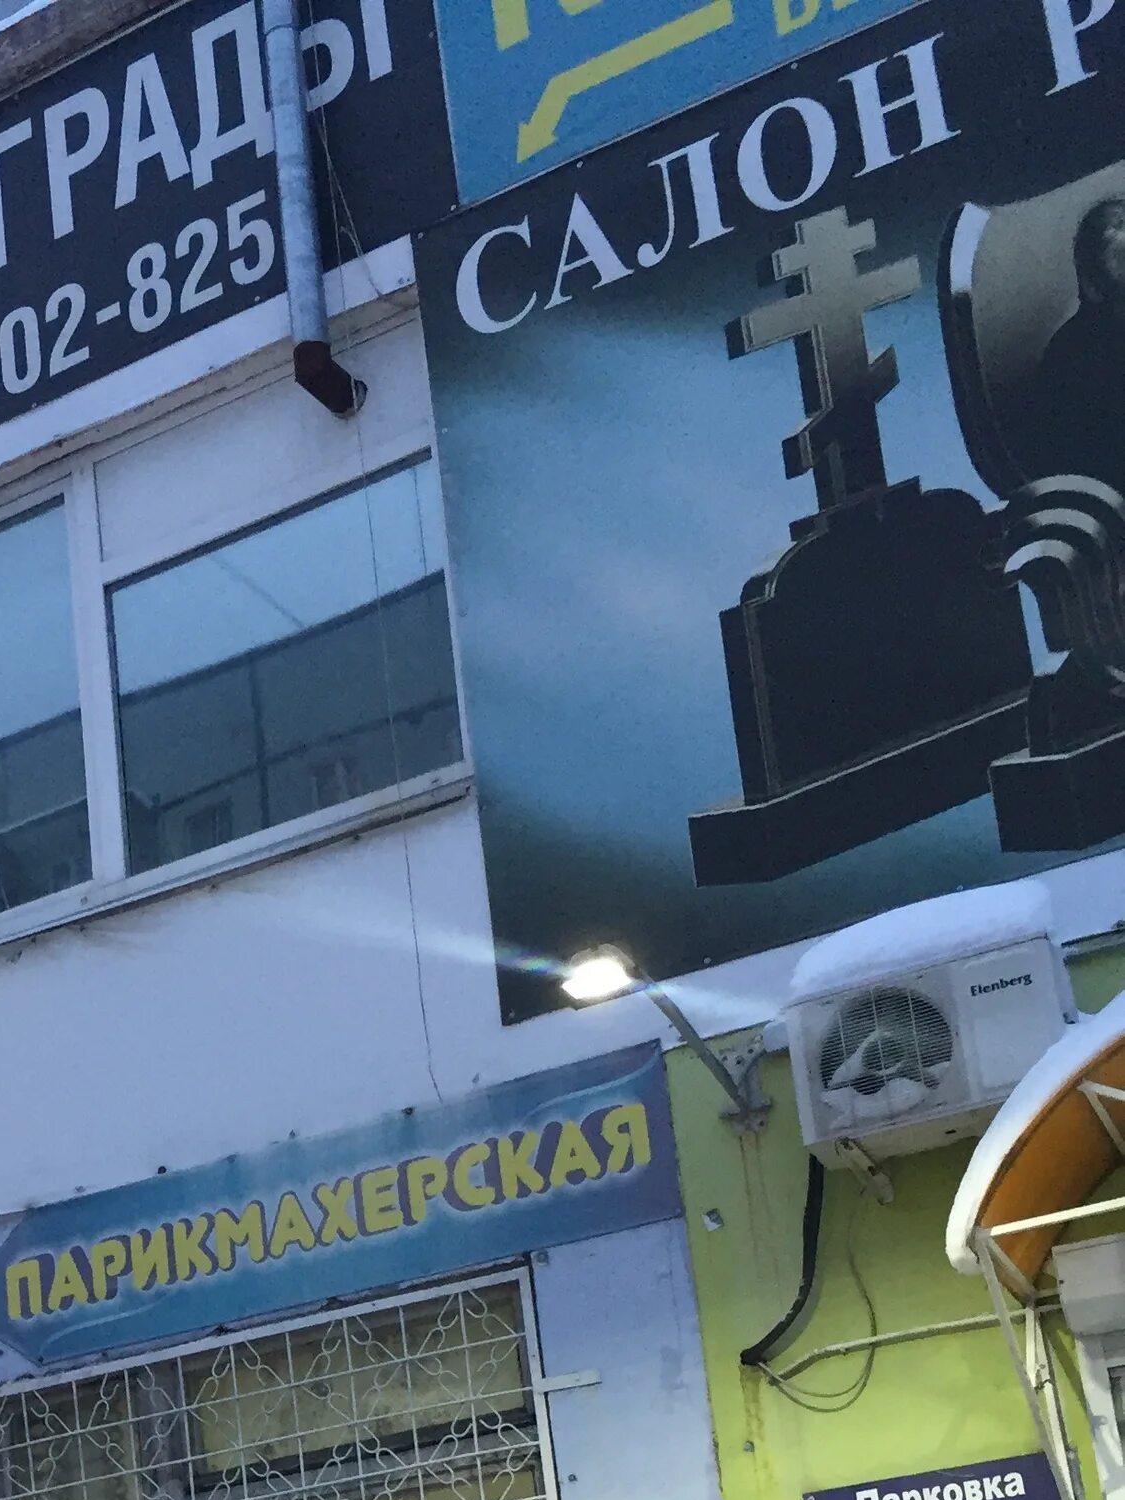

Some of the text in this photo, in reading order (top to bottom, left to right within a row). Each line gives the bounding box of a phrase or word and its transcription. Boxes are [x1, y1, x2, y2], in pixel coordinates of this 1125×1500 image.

[455, 33, 961, 334] САЛОН
[970, 974, 1032, 996] Elenberg
[5, 1103, 651, 1321] ПАРИКМАХЕРСКАЯ
